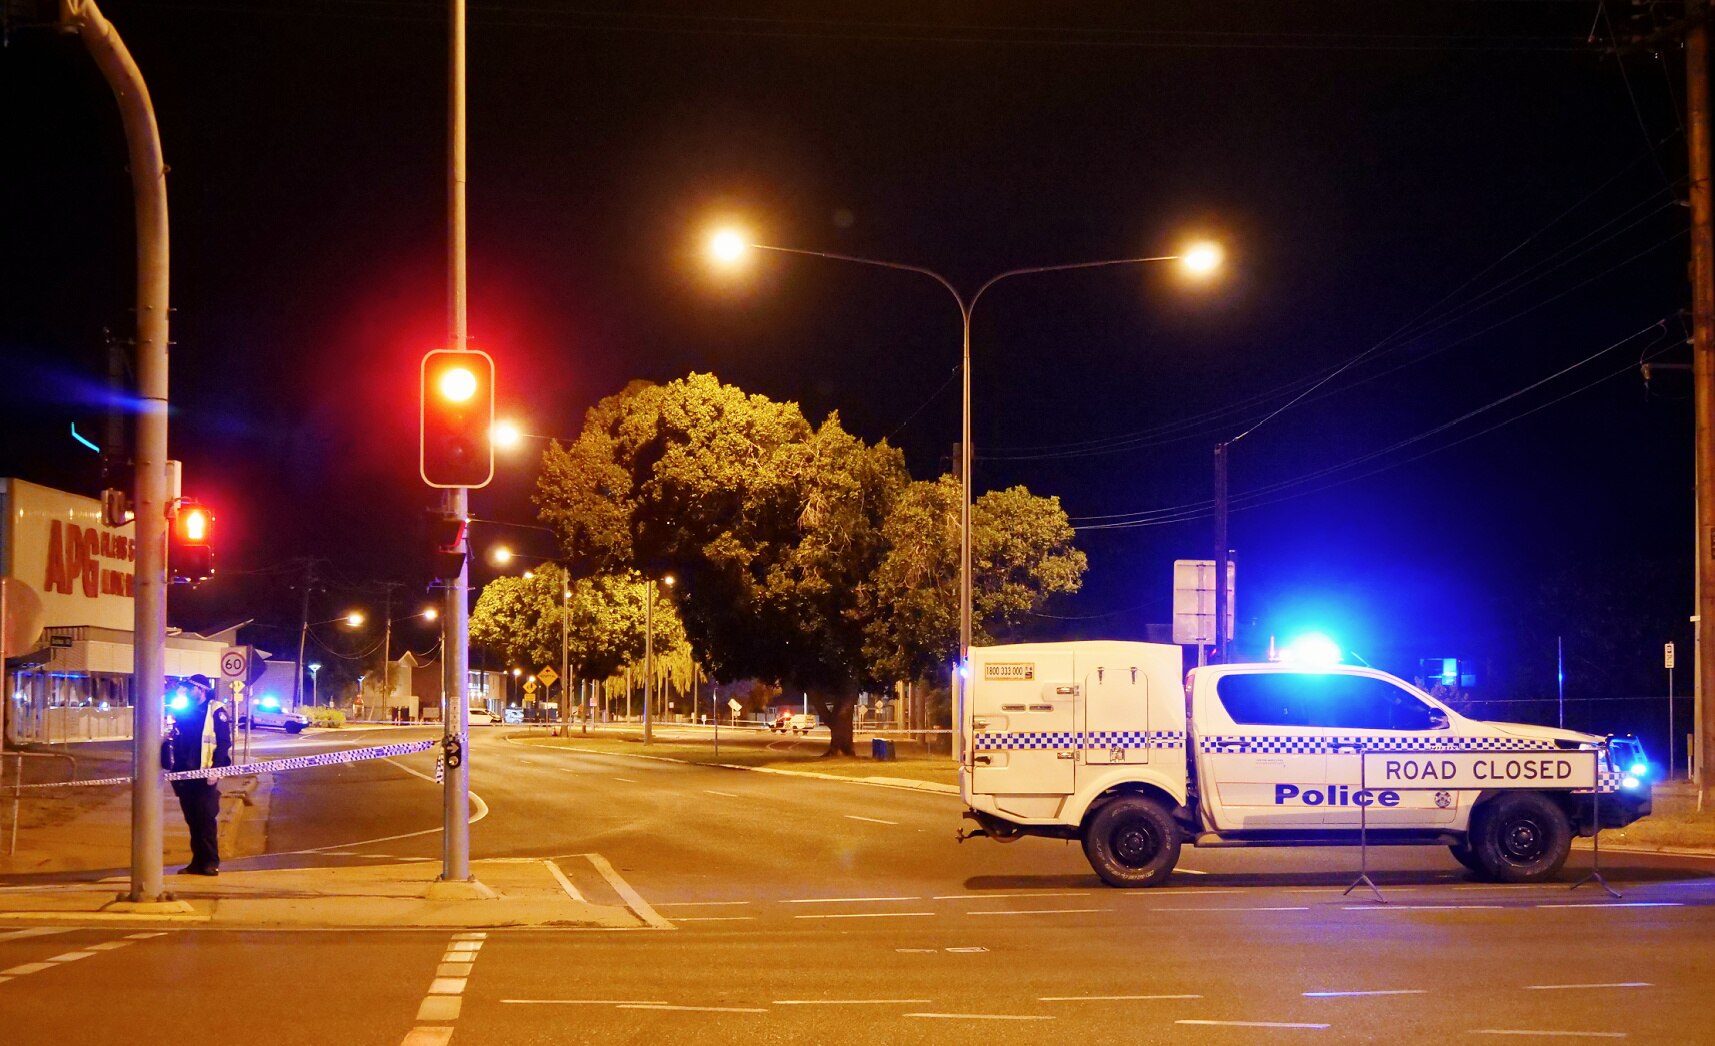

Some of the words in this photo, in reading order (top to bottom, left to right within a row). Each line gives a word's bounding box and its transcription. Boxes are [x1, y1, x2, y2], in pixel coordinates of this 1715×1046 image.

[44, 519, 100, 598] APG
[225, 658, 242, 670] 60
[987, 666, 999, 675] 1800
[1001, 666, 1011, 675] 333
[1012, 666, 1022, 675] 000
[1386, 760, 1457, 780] ROAD
[1472, 760, 1572, 780] CLOSED
[1275, 784, 1400, 807] Police
